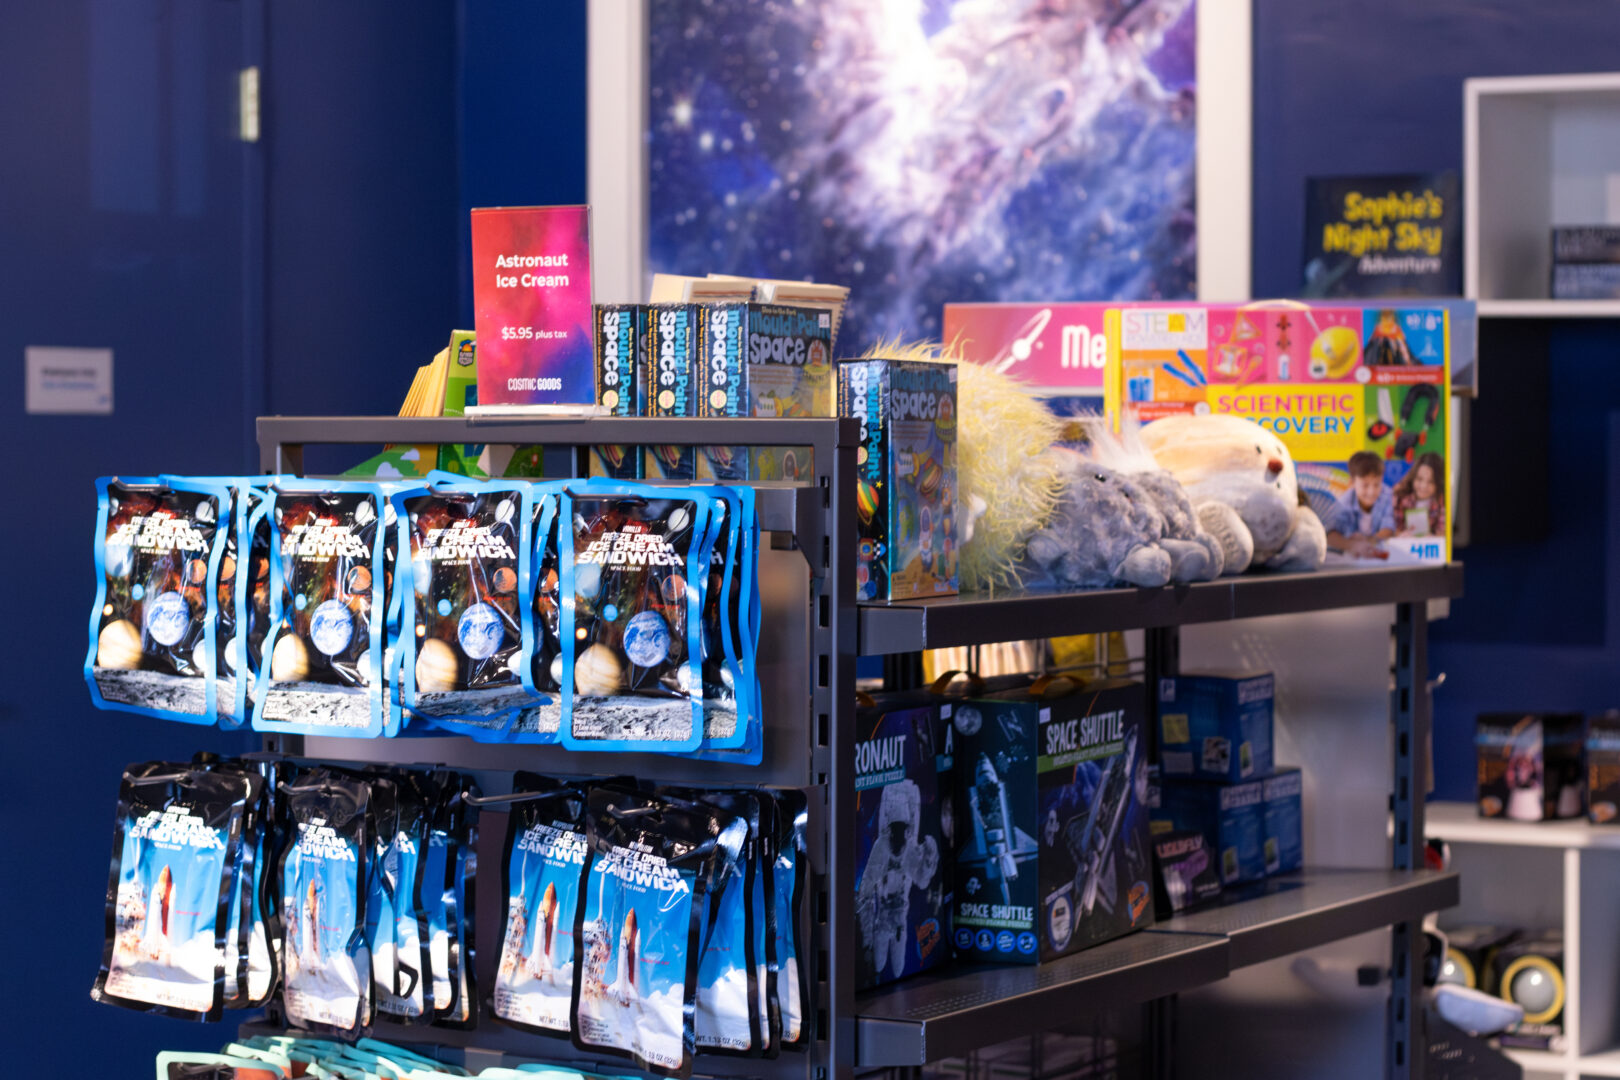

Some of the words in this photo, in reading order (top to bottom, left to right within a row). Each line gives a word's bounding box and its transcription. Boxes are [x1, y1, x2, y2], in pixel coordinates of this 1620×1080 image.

[1344, 189, 1443, 226] Sophie's
[1323, 221, 1391, 258] Night
[1395, 221, 1442, 257] Sky
[495, 253, 569, 268] Astronaut
[1358, 254, 1441, 275] Adventure
[496, 273, 518, 288] Ice
[521, 273, 569, 288] Cream
[501, 326, 533, 341] $5.95
[535, 330, 553, 341] plus
[554, 331, 567, 339] tax
[507, 378, 536, 391] COSMIC
[537, 377, 562, 391] GOODS
[1217, 394, 1354, 413] SCIENTIFIC
[586, 541, 611, 552] ICE
[613, 541, 675, 553] CREAM
[601, 532, 632, 543] FREEZE
[633, 533, 664, 544] DRIED
[577, 551, 685, 566] SANDWICH
[1046, 718, 1078, 755] SPACE
[1080, 709, 1125, 748] SHUTTLE
[855, 734, 906, 775] RONAUT
[523, 830, 542, 842] ICE
[533, 823, 563, 838] FREEZE
[563, 830, 588, 843] DRIED
[517, 838, 587, 865] SANDWIC
[612, 845, 641, 860] FREEZE
[641, 853, 667, 868] DRIED
[603, 851, 621, 865] ICE
[624, 858, 680, 879] CREAM
[594, 859, 690, 893] SANDWICH
[961, 902, 989, 918] SPACE
[991, 904, 1034, 921] SHUTTLE
